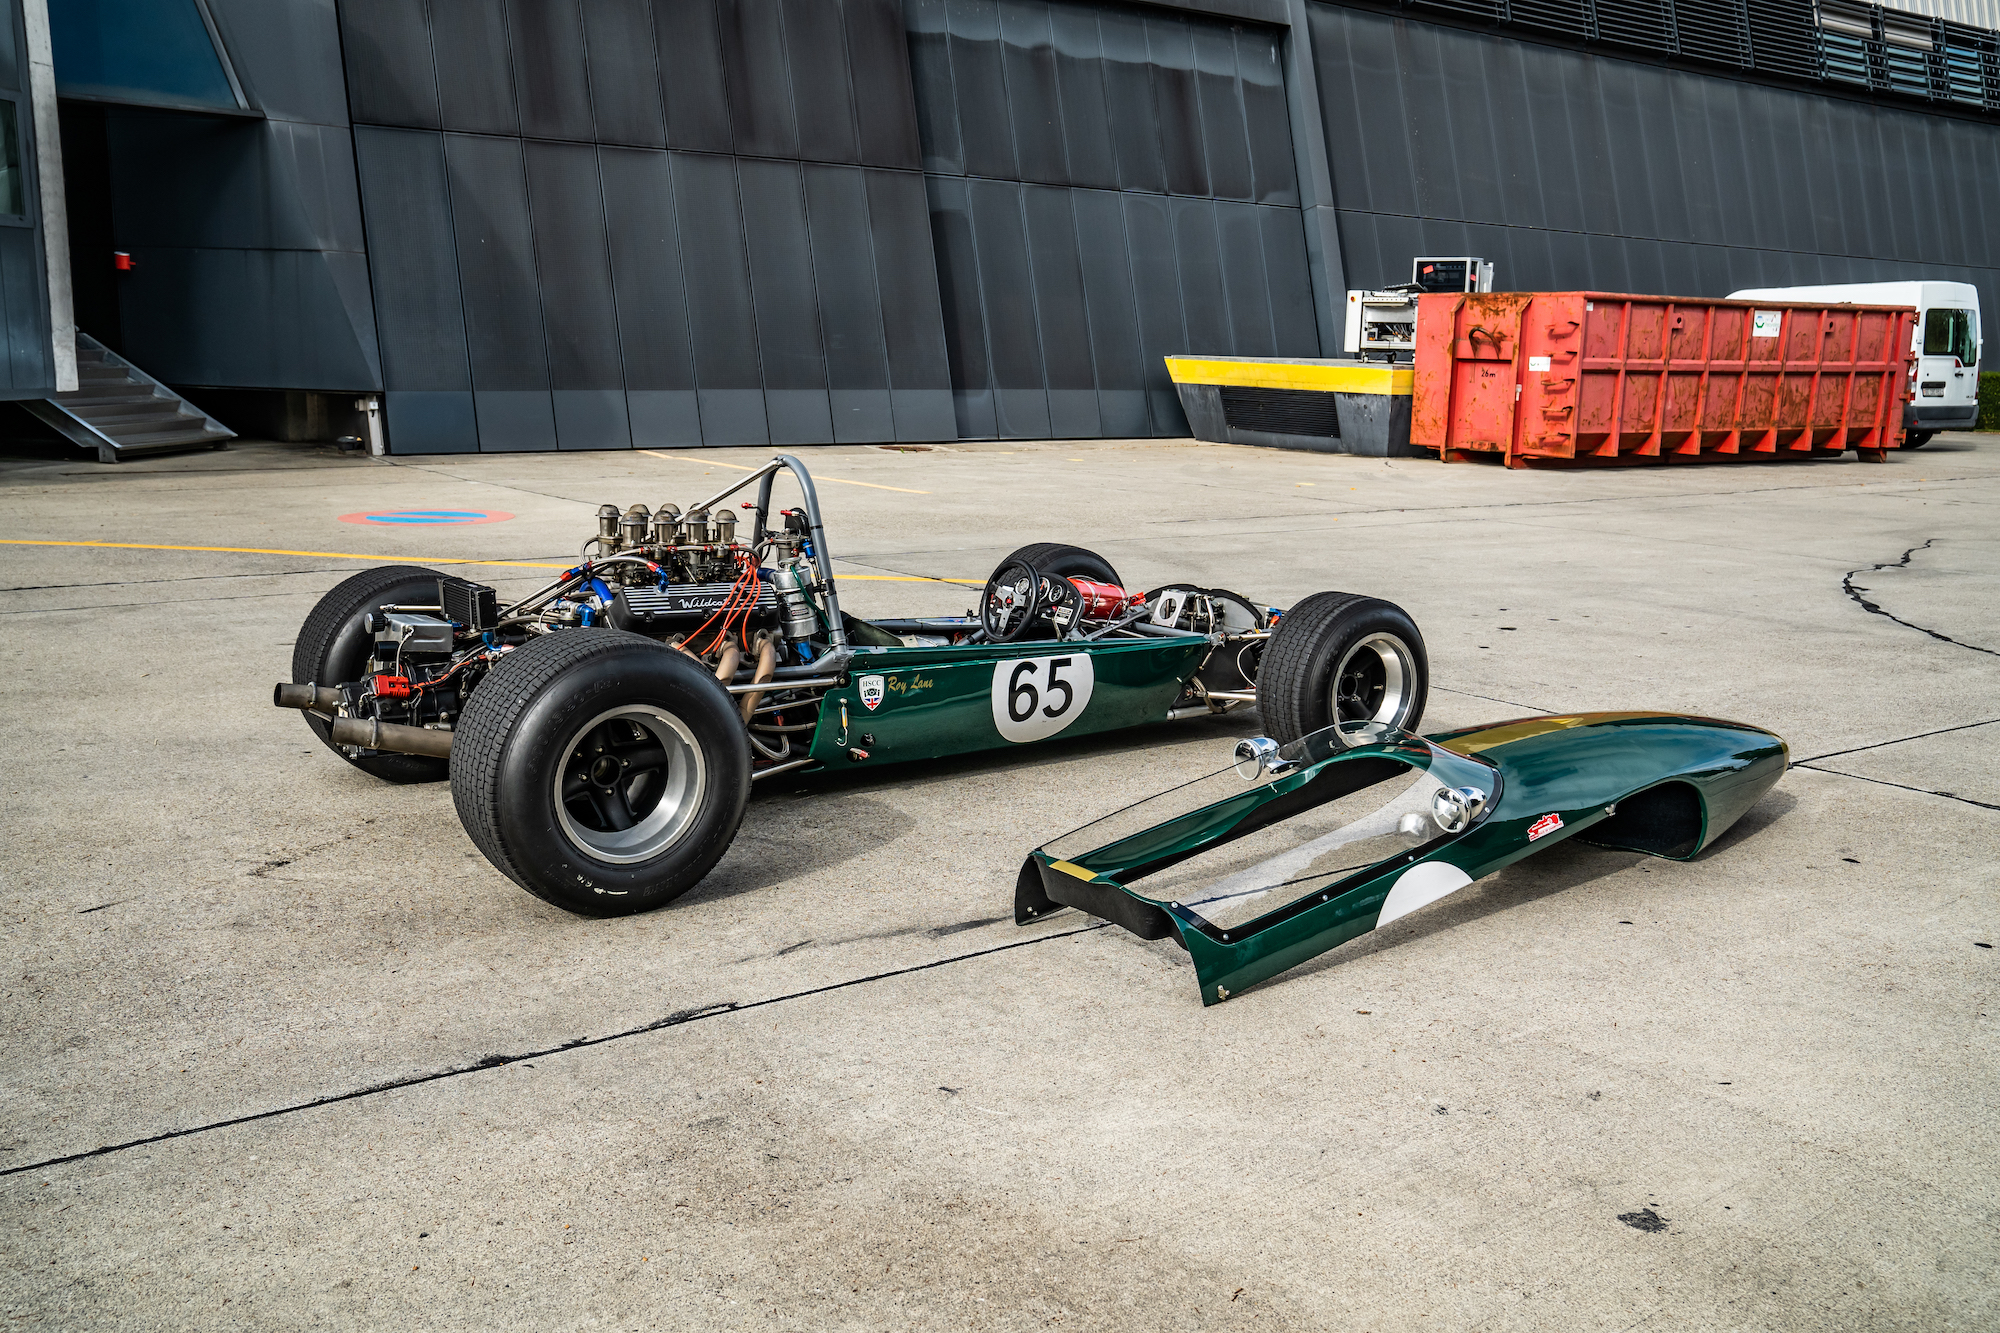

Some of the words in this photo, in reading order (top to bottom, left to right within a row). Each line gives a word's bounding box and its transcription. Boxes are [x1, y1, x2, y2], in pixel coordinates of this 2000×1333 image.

[888, 676, 907, 694] Roy
[911, 674, 933, 689] Lane
[1008, 657, 1073, 722] 65
